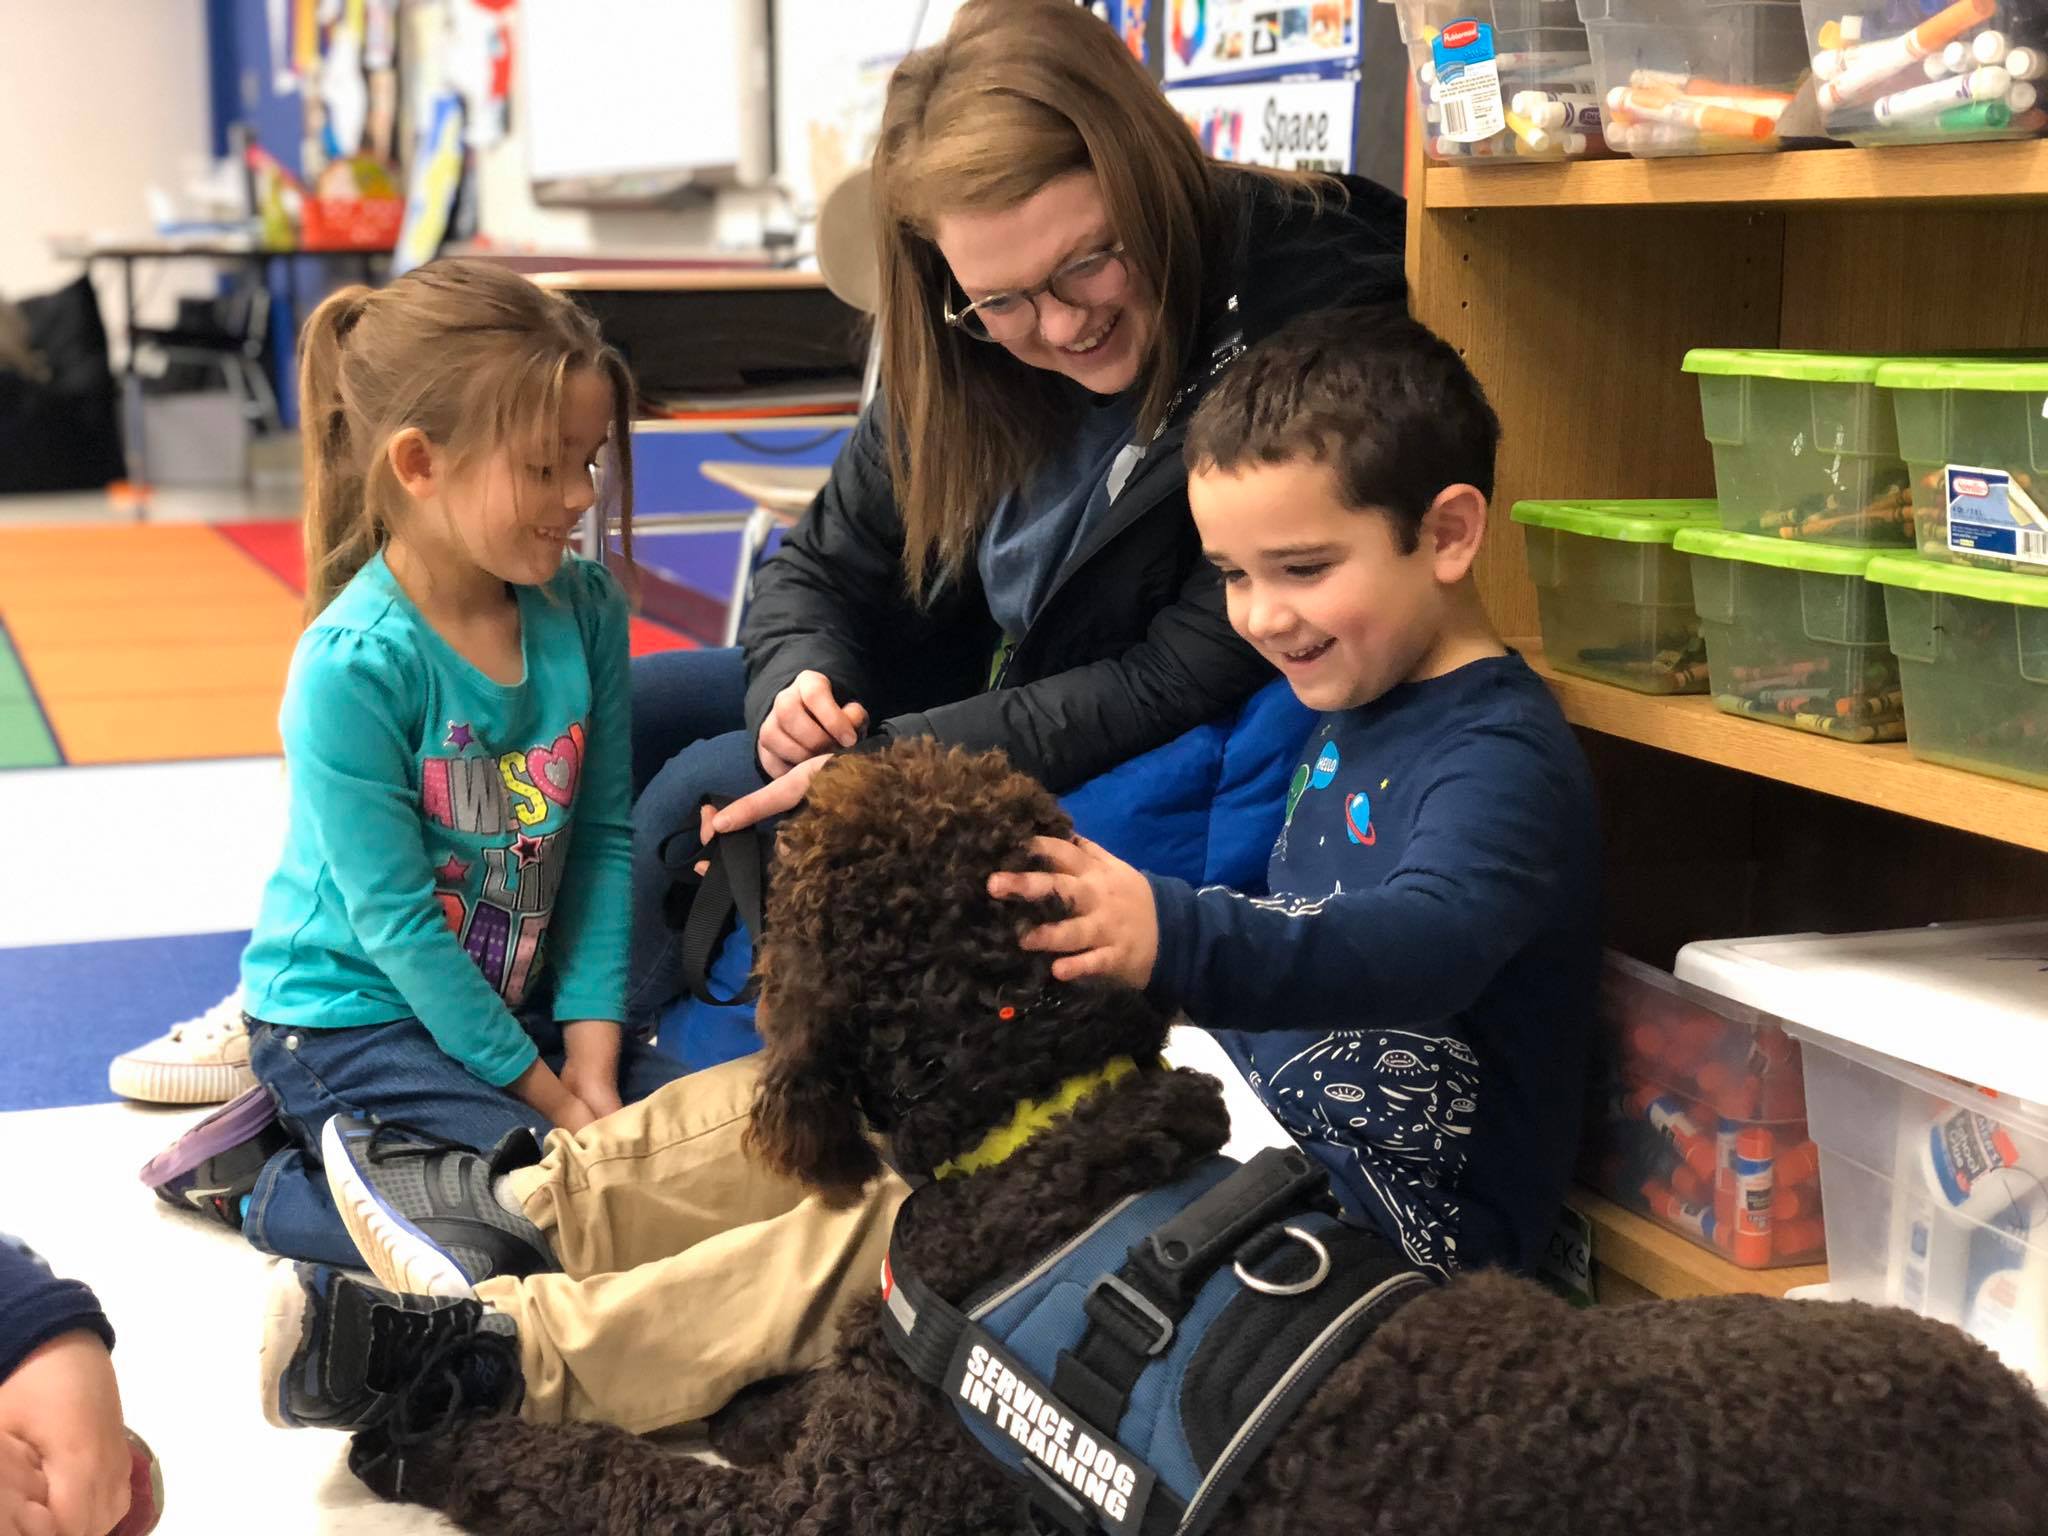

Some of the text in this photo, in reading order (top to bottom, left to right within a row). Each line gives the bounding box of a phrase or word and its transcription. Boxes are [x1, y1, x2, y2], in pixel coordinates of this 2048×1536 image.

[1261, 96, 1328, 166] Space
[1316, 757, 1337, 773] HELLO
[960, 1375, 1128, 1522] IN TRAINING
[967, 1345, 1136, 1497] SERVICE DOG
